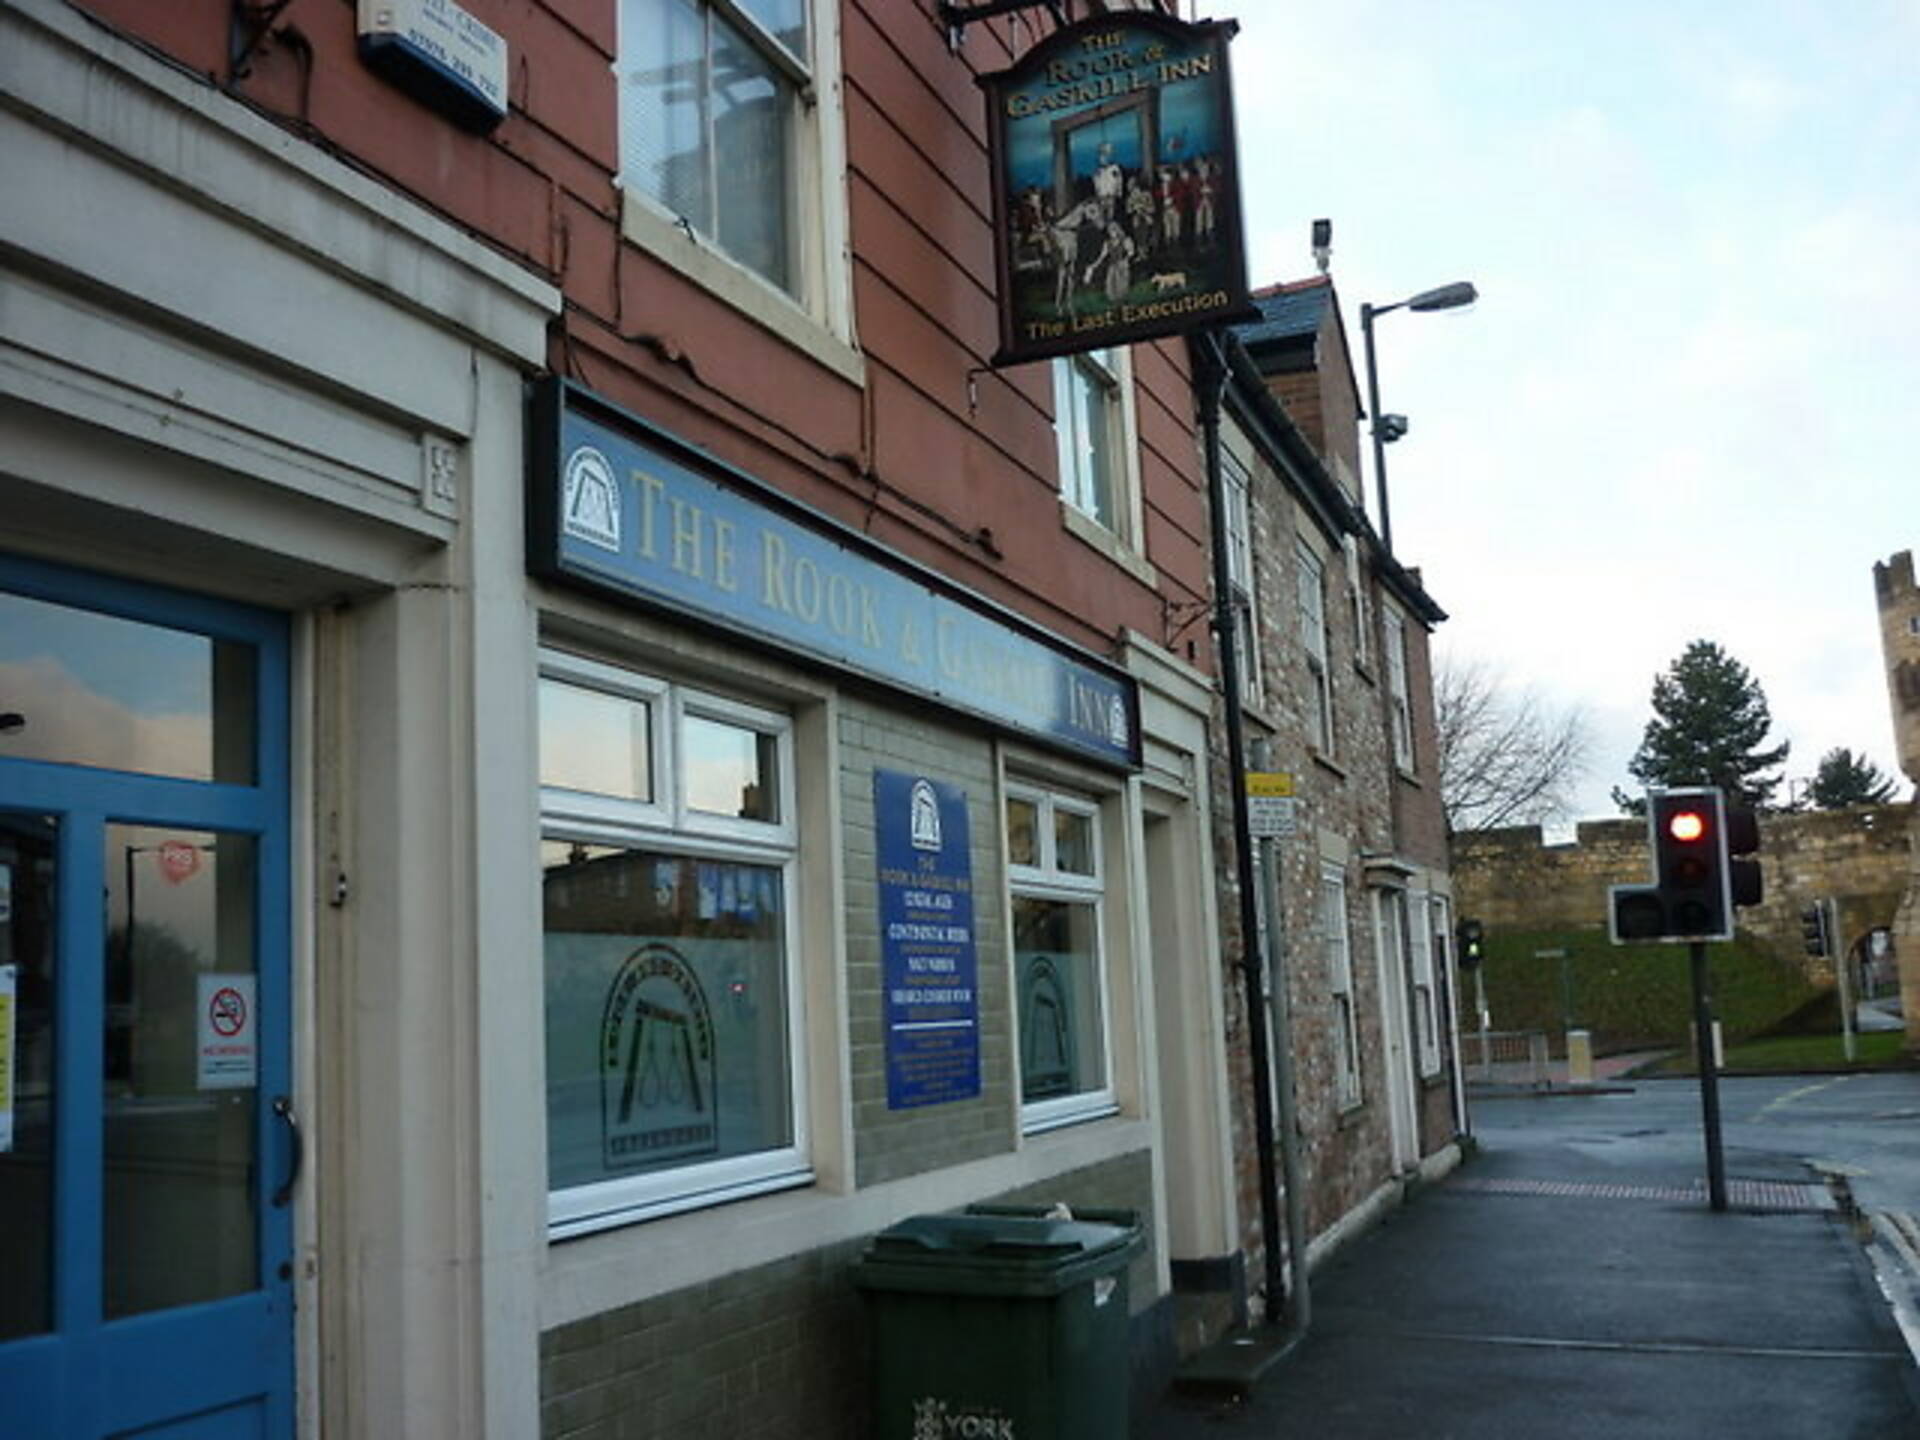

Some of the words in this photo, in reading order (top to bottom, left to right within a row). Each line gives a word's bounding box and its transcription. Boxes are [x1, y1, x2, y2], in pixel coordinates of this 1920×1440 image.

[1081, 31, 1126, 49] THE
[1007, 71, 1149, 120] GASKILL
[1158, 53, 1215, 83] INN
[1045, 50, 1133, 87] ROOK
[1026, 321, 1067, 341] The
[1071, 310, 1117, 332] Last
[1121, 289, 1229, 323] Execution
[628, 469, 738, 591] THE
[760, 528, 882, 651] ROOK
[1069, 673, 1110, 738] INN
[944, 1413, 1014, 1440] YORK
